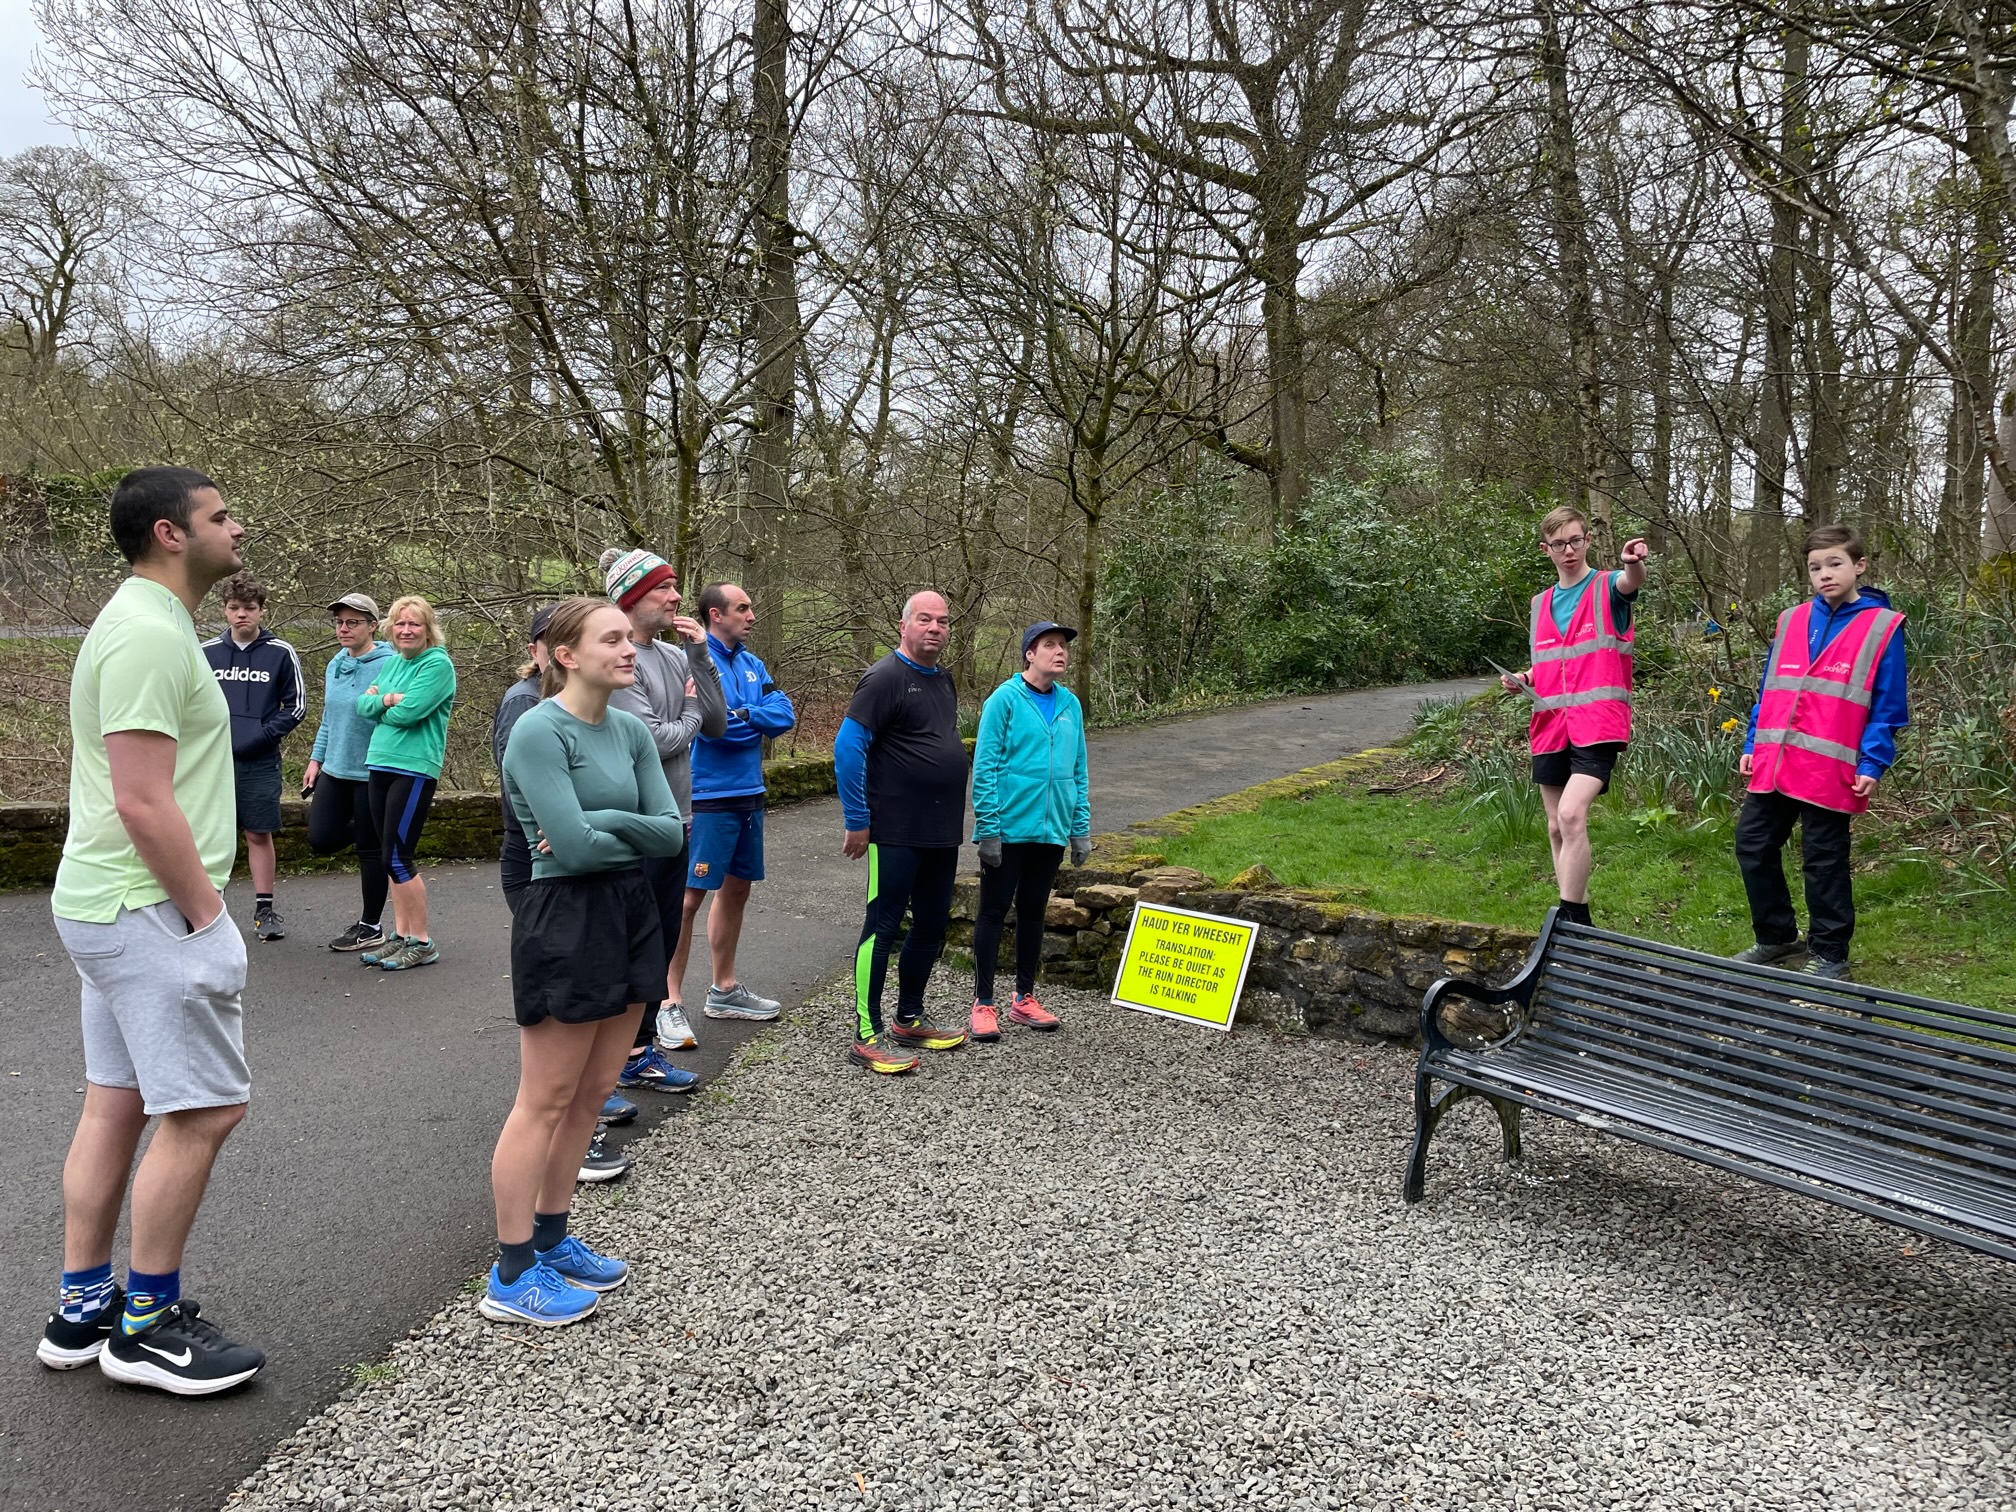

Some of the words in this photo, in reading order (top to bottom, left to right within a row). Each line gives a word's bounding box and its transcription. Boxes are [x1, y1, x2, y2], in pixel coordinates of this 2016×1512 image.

[213, 666, 270, 682] adidas
[1142, 915, 1169, 931] HAUD
[1172, 921, 1191, 936] YER
[1193, 925, 1244, 946] WHEESHT
[1155, 939, 1216, 961] TRANSLATION:
[1138, 950, 1171, 967] PLEASE
[1172, 957, 1184, 970] BE
[1185, 960, 1212, 976] QUIET
[1212, 967, 1226, 979] AS
[1138, 965, 1153, 979] THE
[1155, 969, 1174, 983] RUN
[1175, 974, 1219, 993] DIRECTOR
[1149, 984, 1159, 995] IS
[1161, 986, 1197, 1004] TALKING
